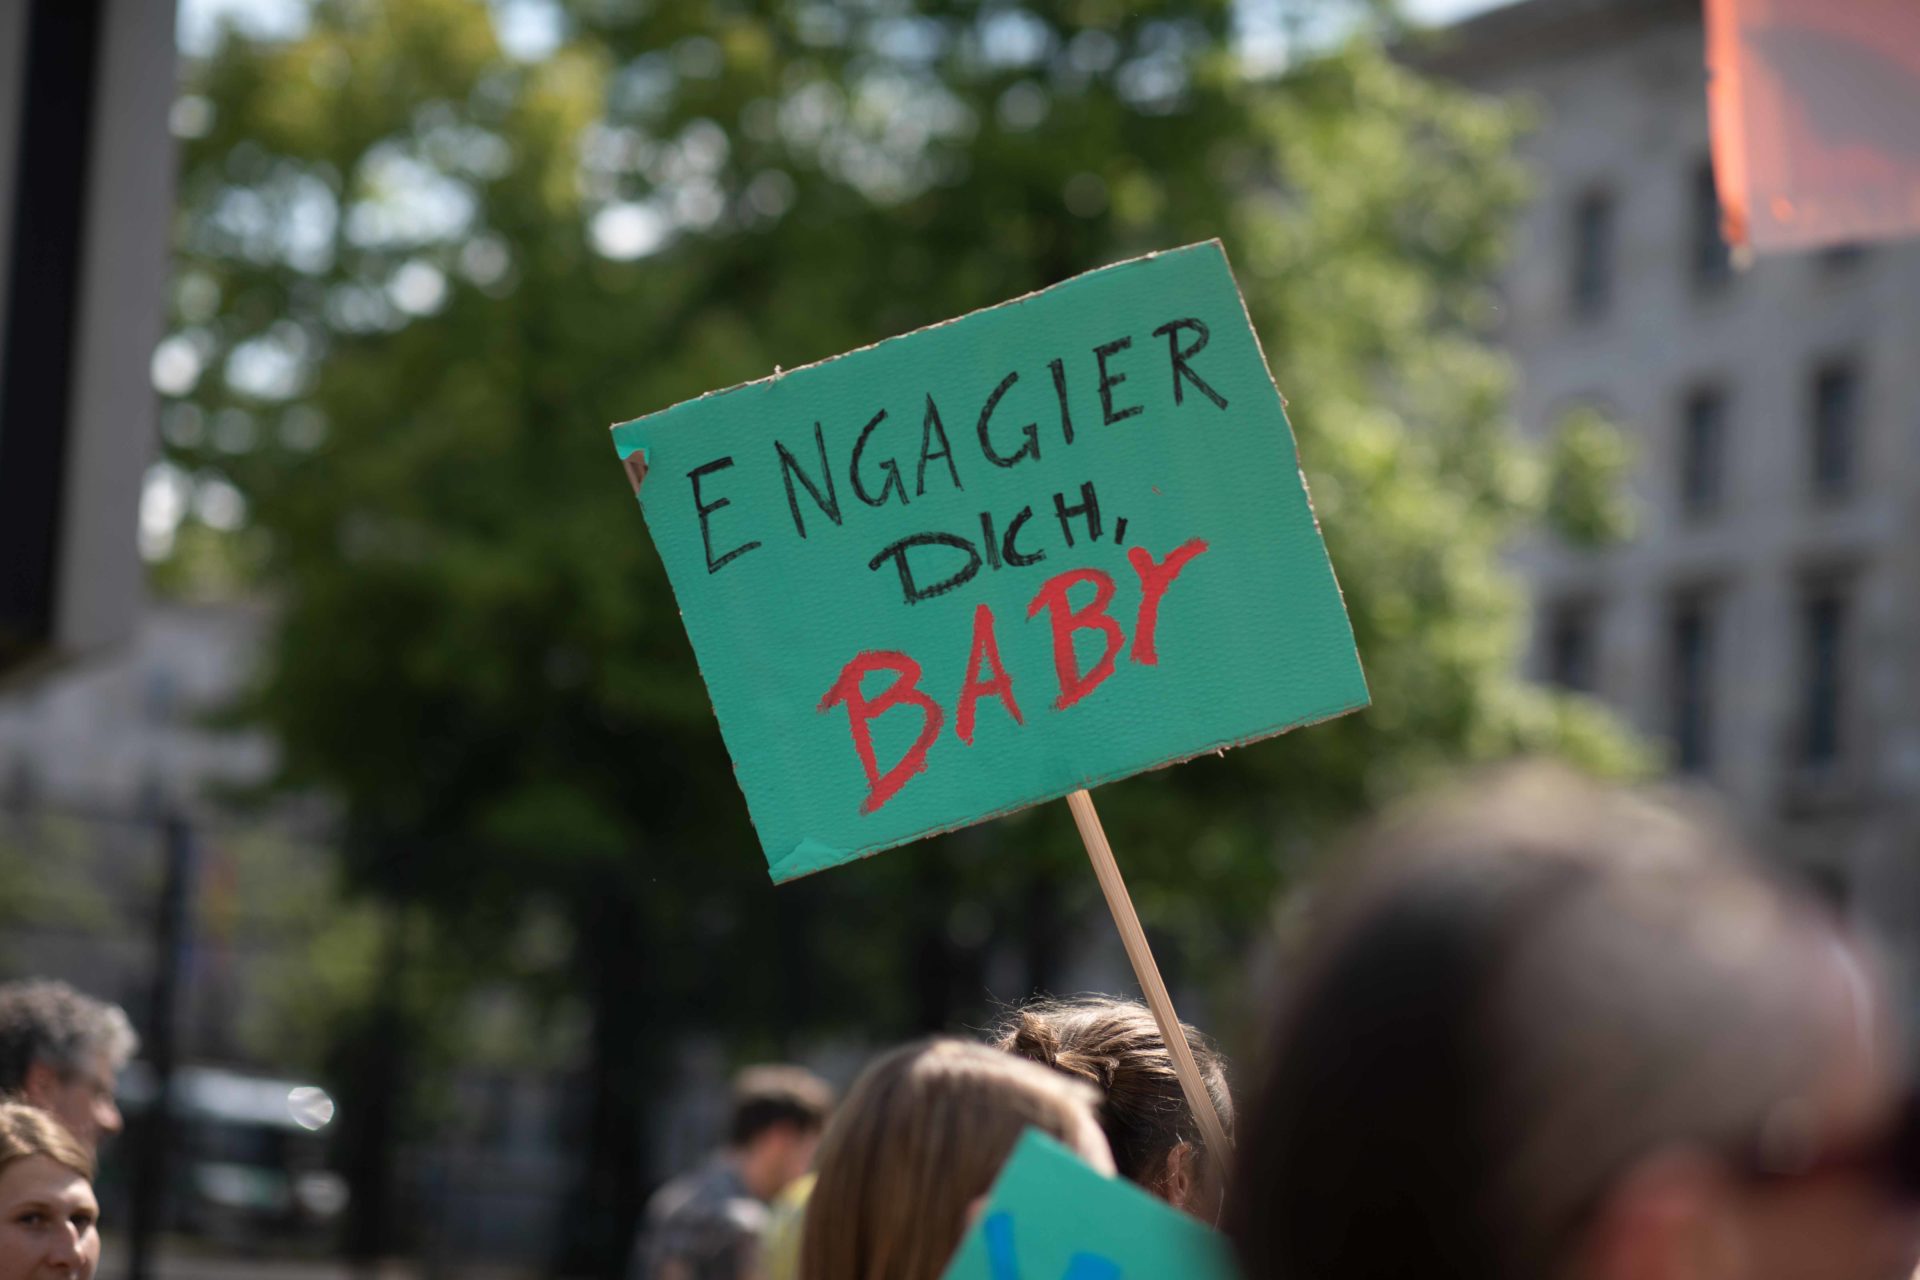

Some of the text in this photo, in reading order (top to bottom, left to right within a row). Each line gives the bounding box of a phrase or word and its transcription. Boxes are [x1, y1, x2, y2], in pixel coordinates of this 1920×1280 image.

[685, 317, 1229, 575] ENGAGIER
[868, 481, 1129, 606] DICH,
[816, 538, 1209, 815] BABY
